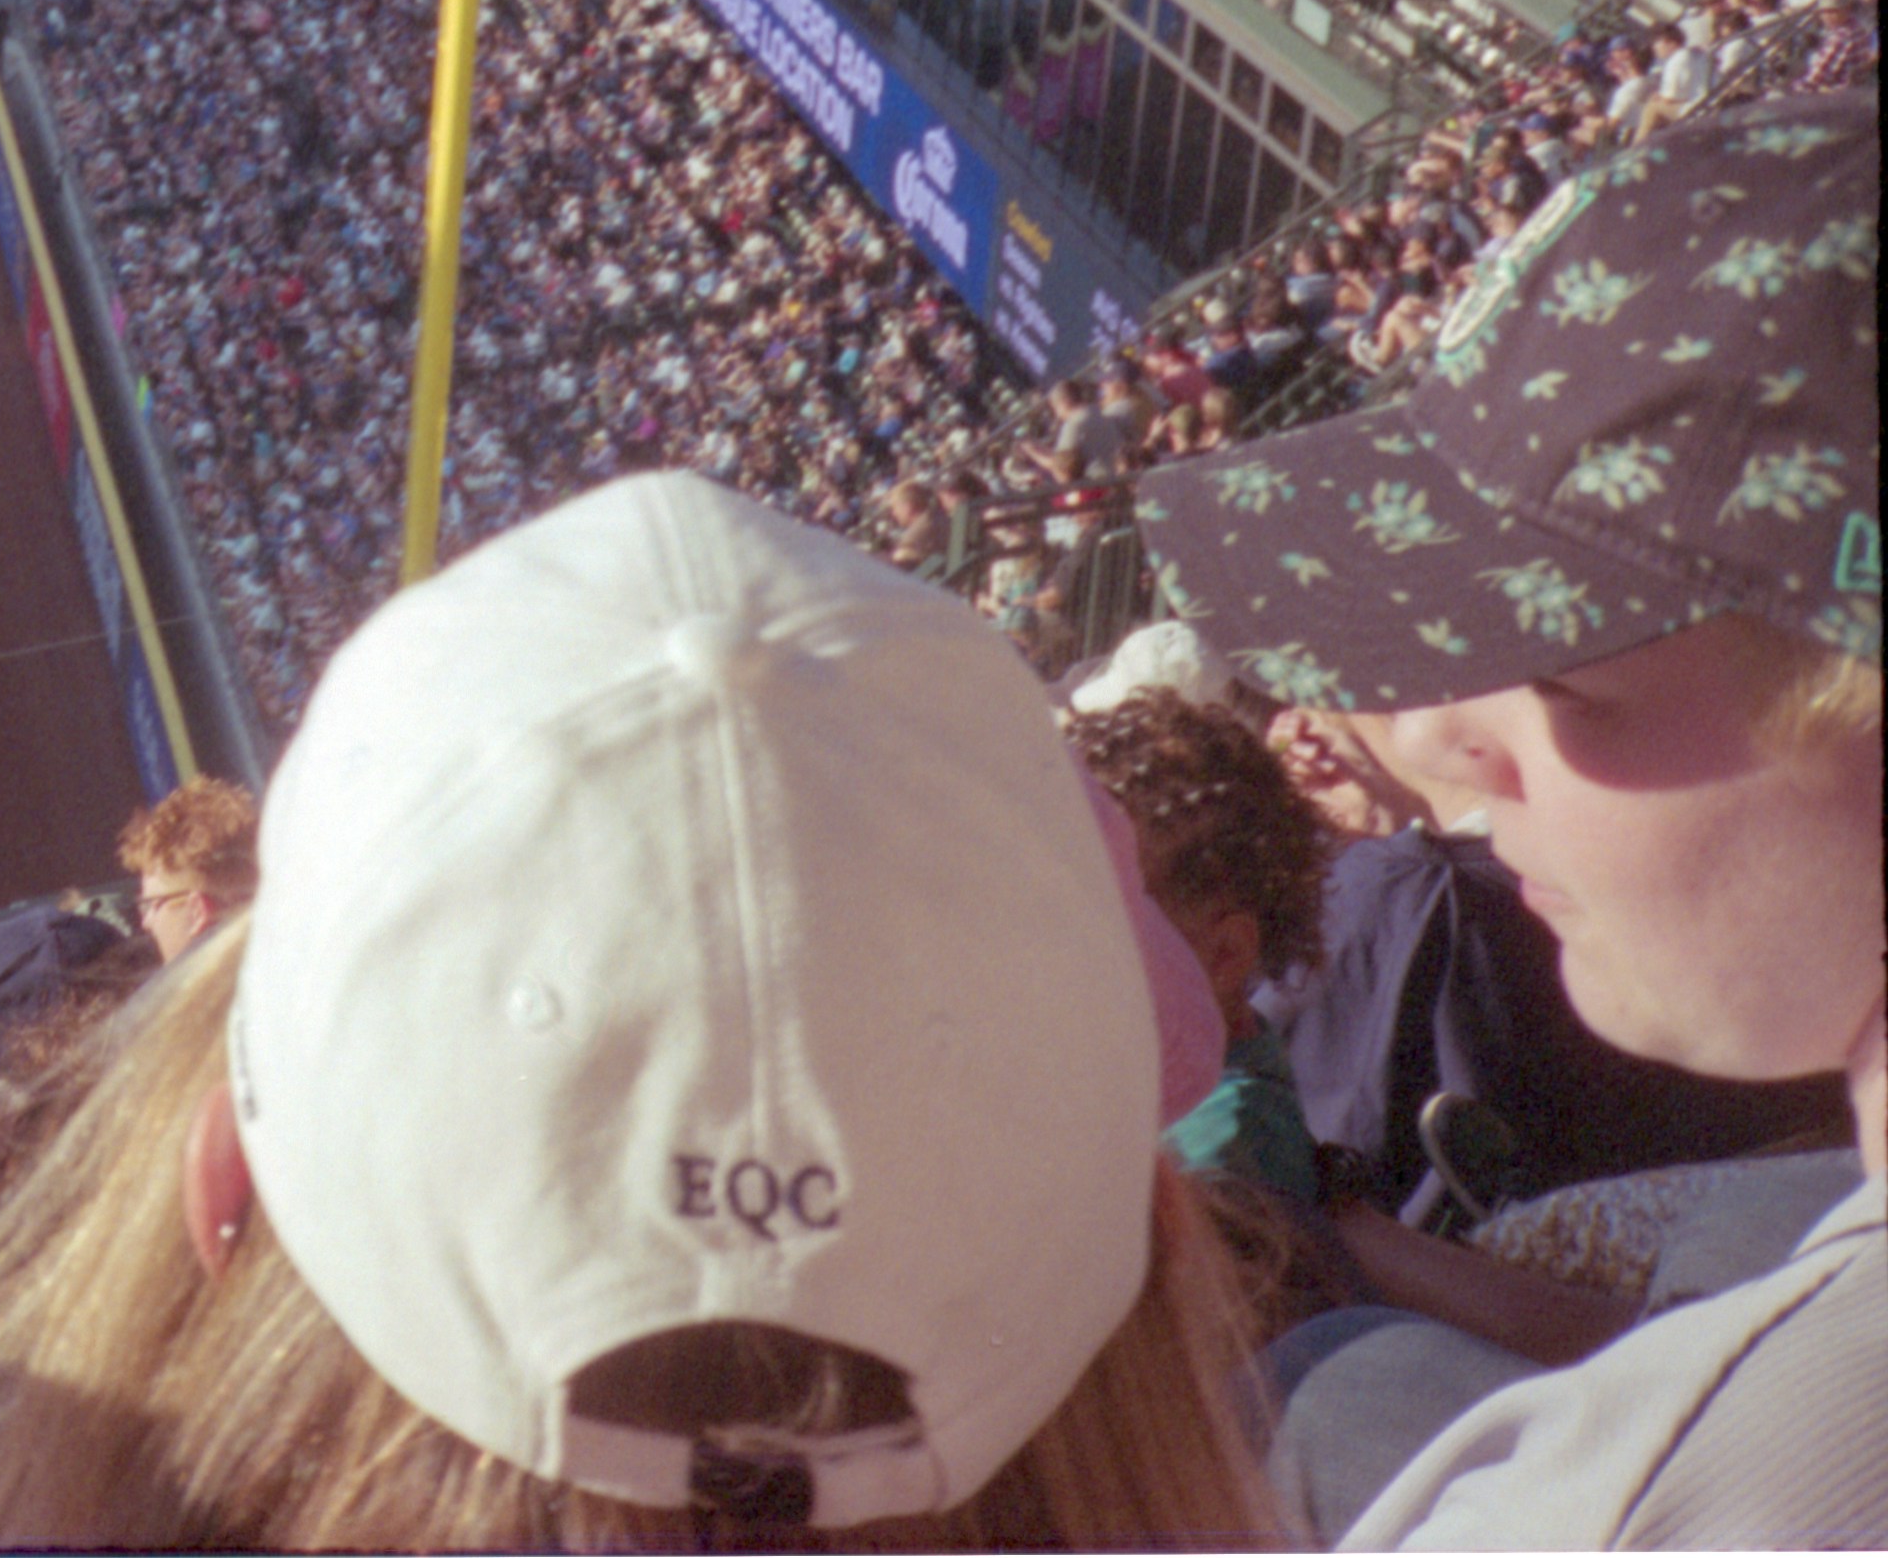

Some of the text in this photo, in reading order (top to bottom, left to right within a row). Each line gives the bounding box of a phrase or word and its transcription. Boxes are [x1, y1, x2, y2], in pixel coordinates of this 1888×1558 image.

[758, 16, 855, 153] LOCATION
[835, 31, 884, 117] BAR
[671, 1154, 841, 1243] EQC
